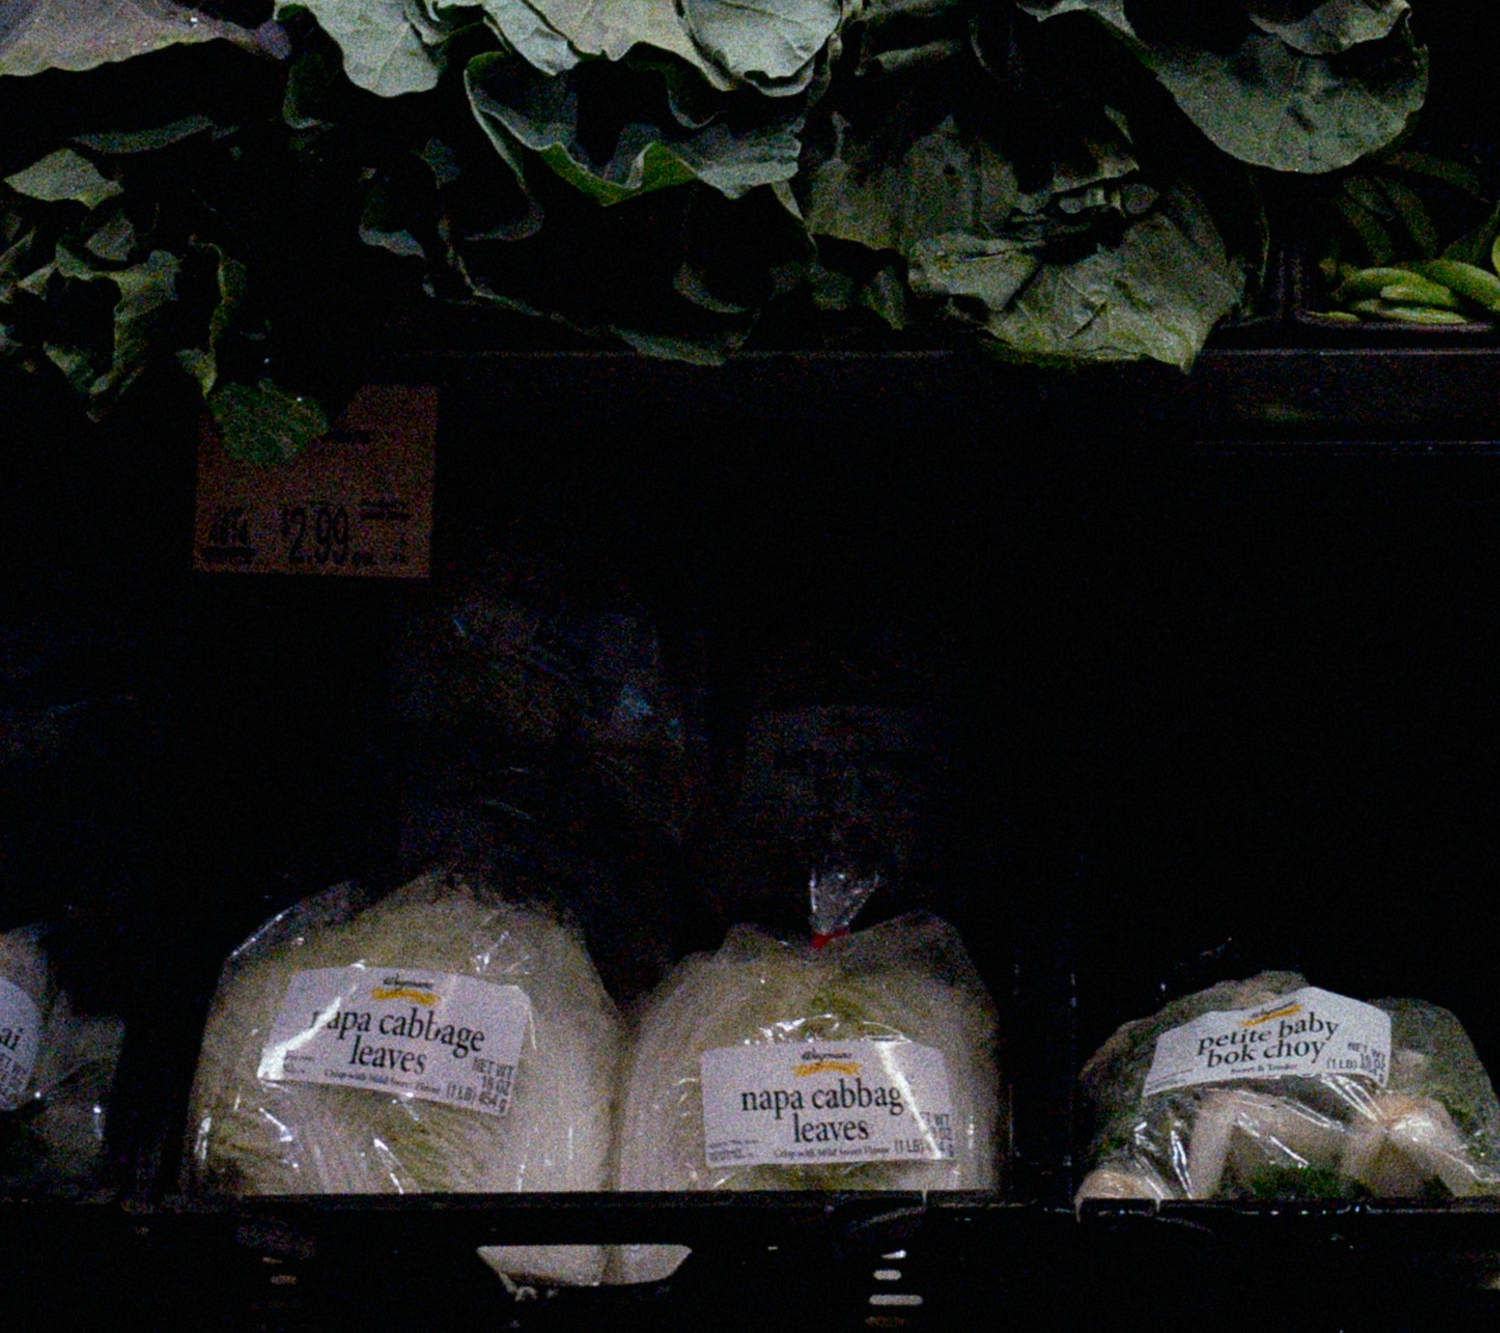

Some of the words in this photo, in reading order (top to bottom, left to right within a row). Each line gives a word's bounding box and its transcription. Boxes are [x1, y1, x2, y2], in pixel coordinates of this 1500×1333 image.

[379, 1007, 486, 1059] cabbage
[1197, 1026, 1272, 1056] petite
[1279, 1012, 1339, 1045] baby
[1206, 1043, 1255, 1068] bok
[1263, 1039, 1328, 1064] choy
[349, 1035, 428, 1075] leaves
[741, 1087, 803, 1120] napa
[811, 1078, 905, 1117] cabbag
[794, 1113, 870, 1144] leaves
